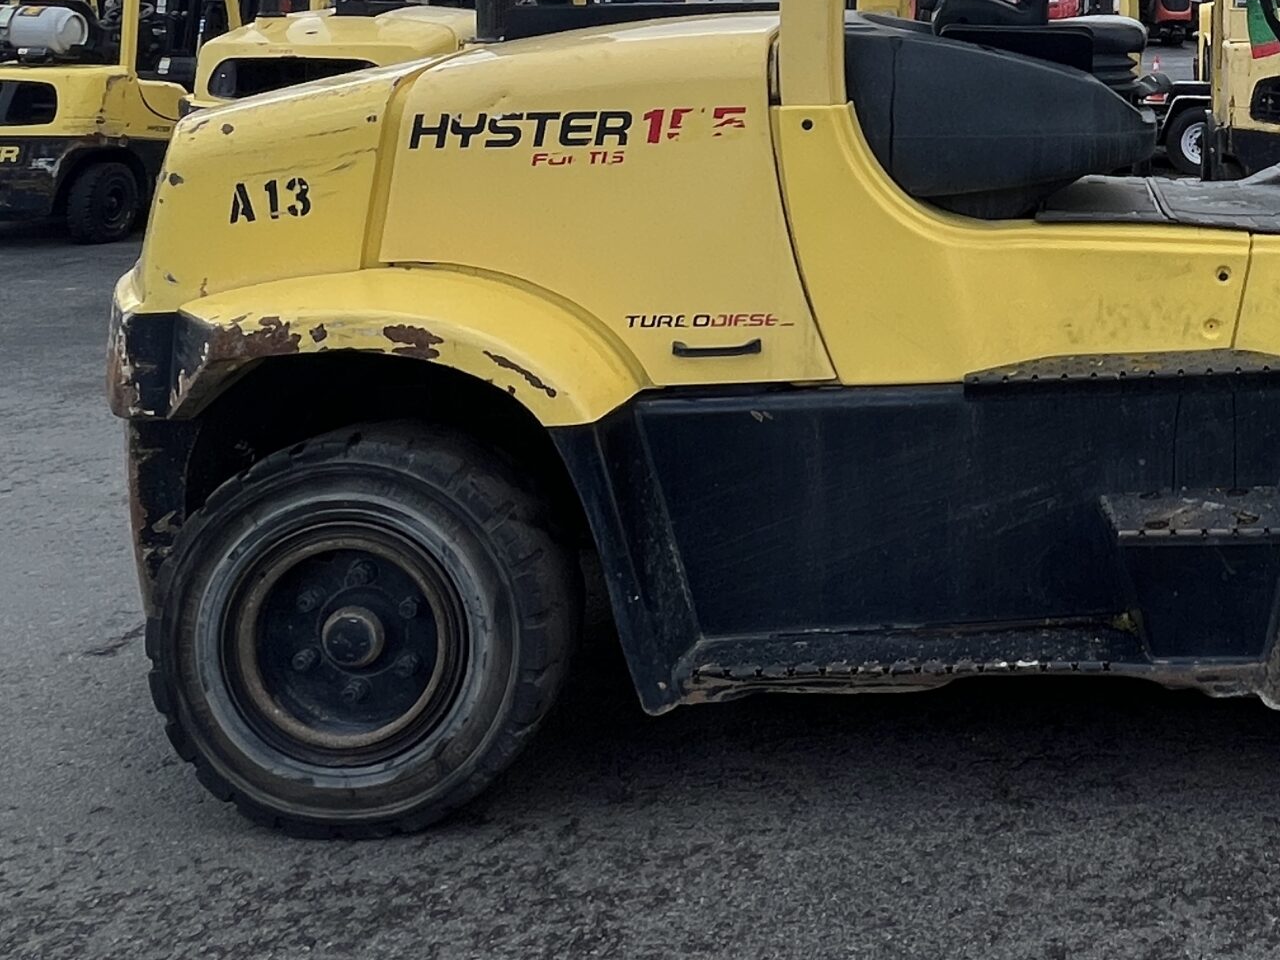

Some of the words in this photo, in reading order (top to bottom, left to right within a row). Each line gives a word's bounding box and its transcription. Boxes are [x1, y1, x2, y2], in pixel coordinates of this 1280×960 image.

[408, 111, 632, 149] HYSTER
[531, 151, 624, 166] FOTIS
[230, 178, 311, 224] A13
